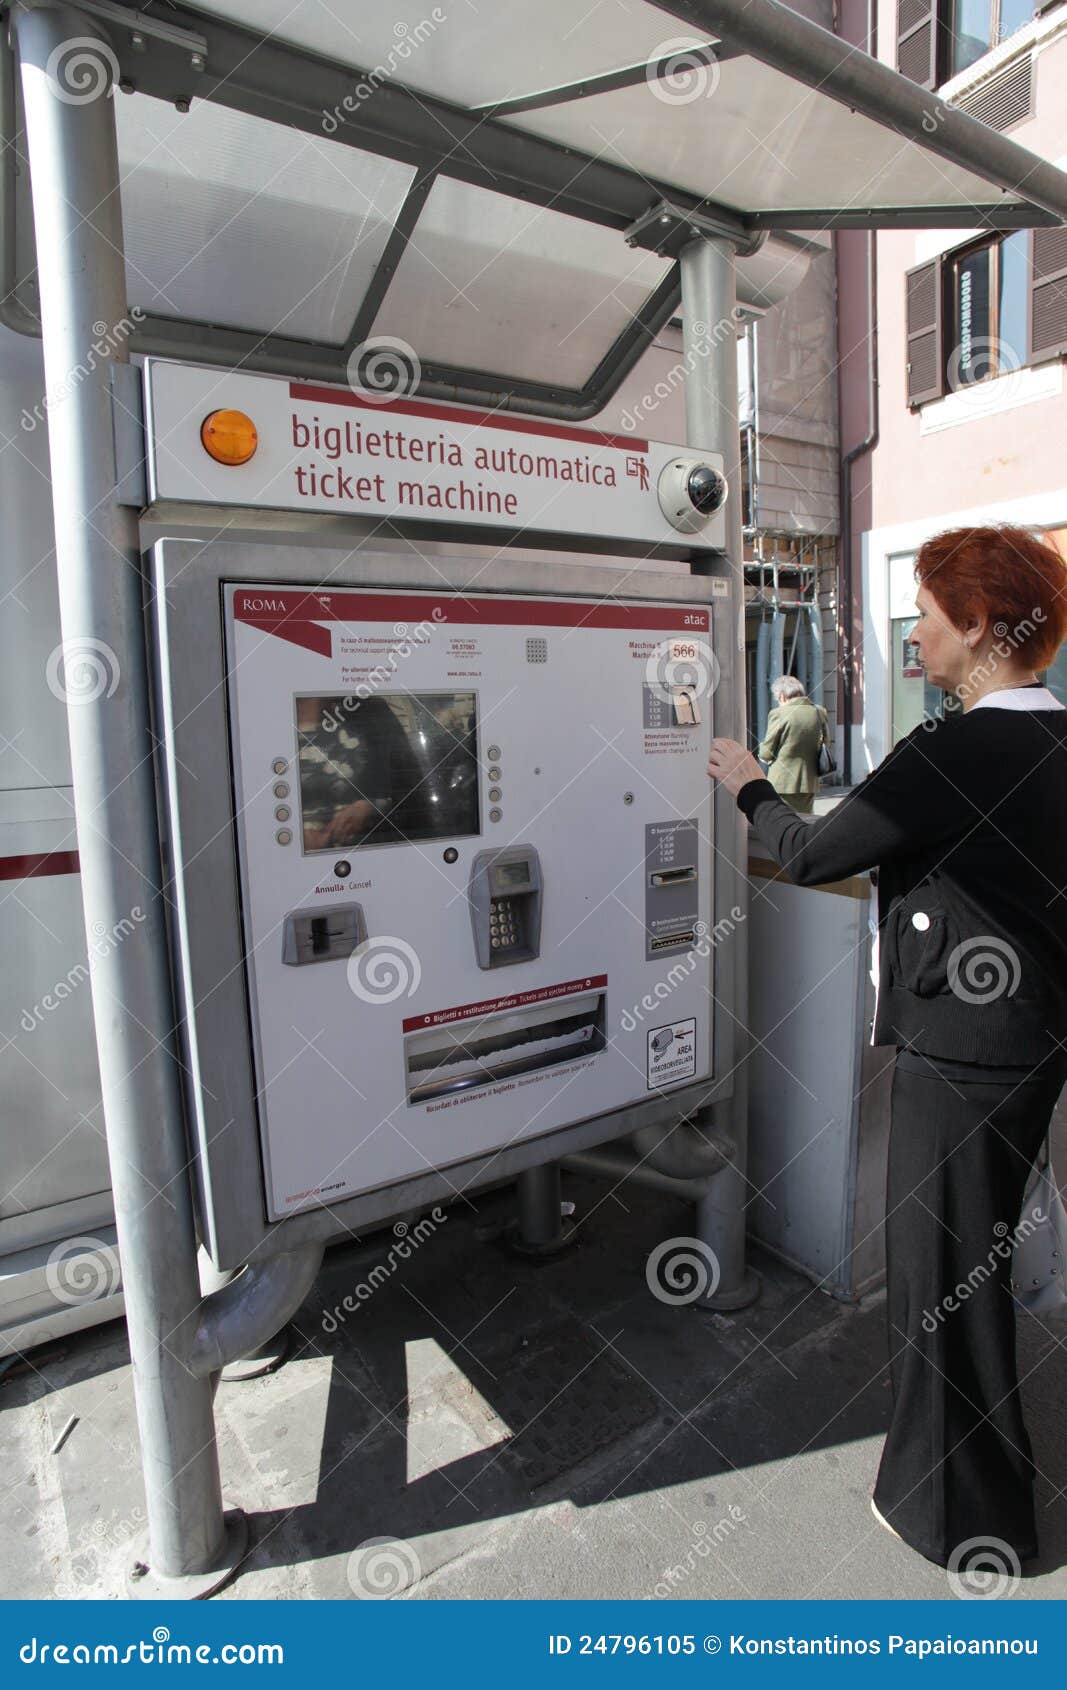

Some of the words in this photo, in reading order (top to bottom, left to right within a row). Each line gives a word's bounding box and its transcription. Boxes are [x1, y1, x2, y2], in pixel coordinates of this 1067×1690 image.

[961, 270, 972, 370] ROSSOPOMODORO
[291, 413, 463, 468] biglietteria
[474, 445, 617, 488] automatica
[295, 464, 386, 503] ticket
[398, 474, 518, 516] machine
[243, 598, 287, 612] ROMA
[684, 614, 705, 626] atac
[629, 641, 656, 650] Macchina
[673, 643, 696, 658] 566
[315, 884, 344, 894] Annulla
[349, 880, 372, 889] Cancel
[433, 1010, 457, 1024] Biglietti
[463, 1002, 497, 1016] restituzione
[677, 1045, 692, 1055] AREA
[426, 1100, 453, 1113] Ricordati
